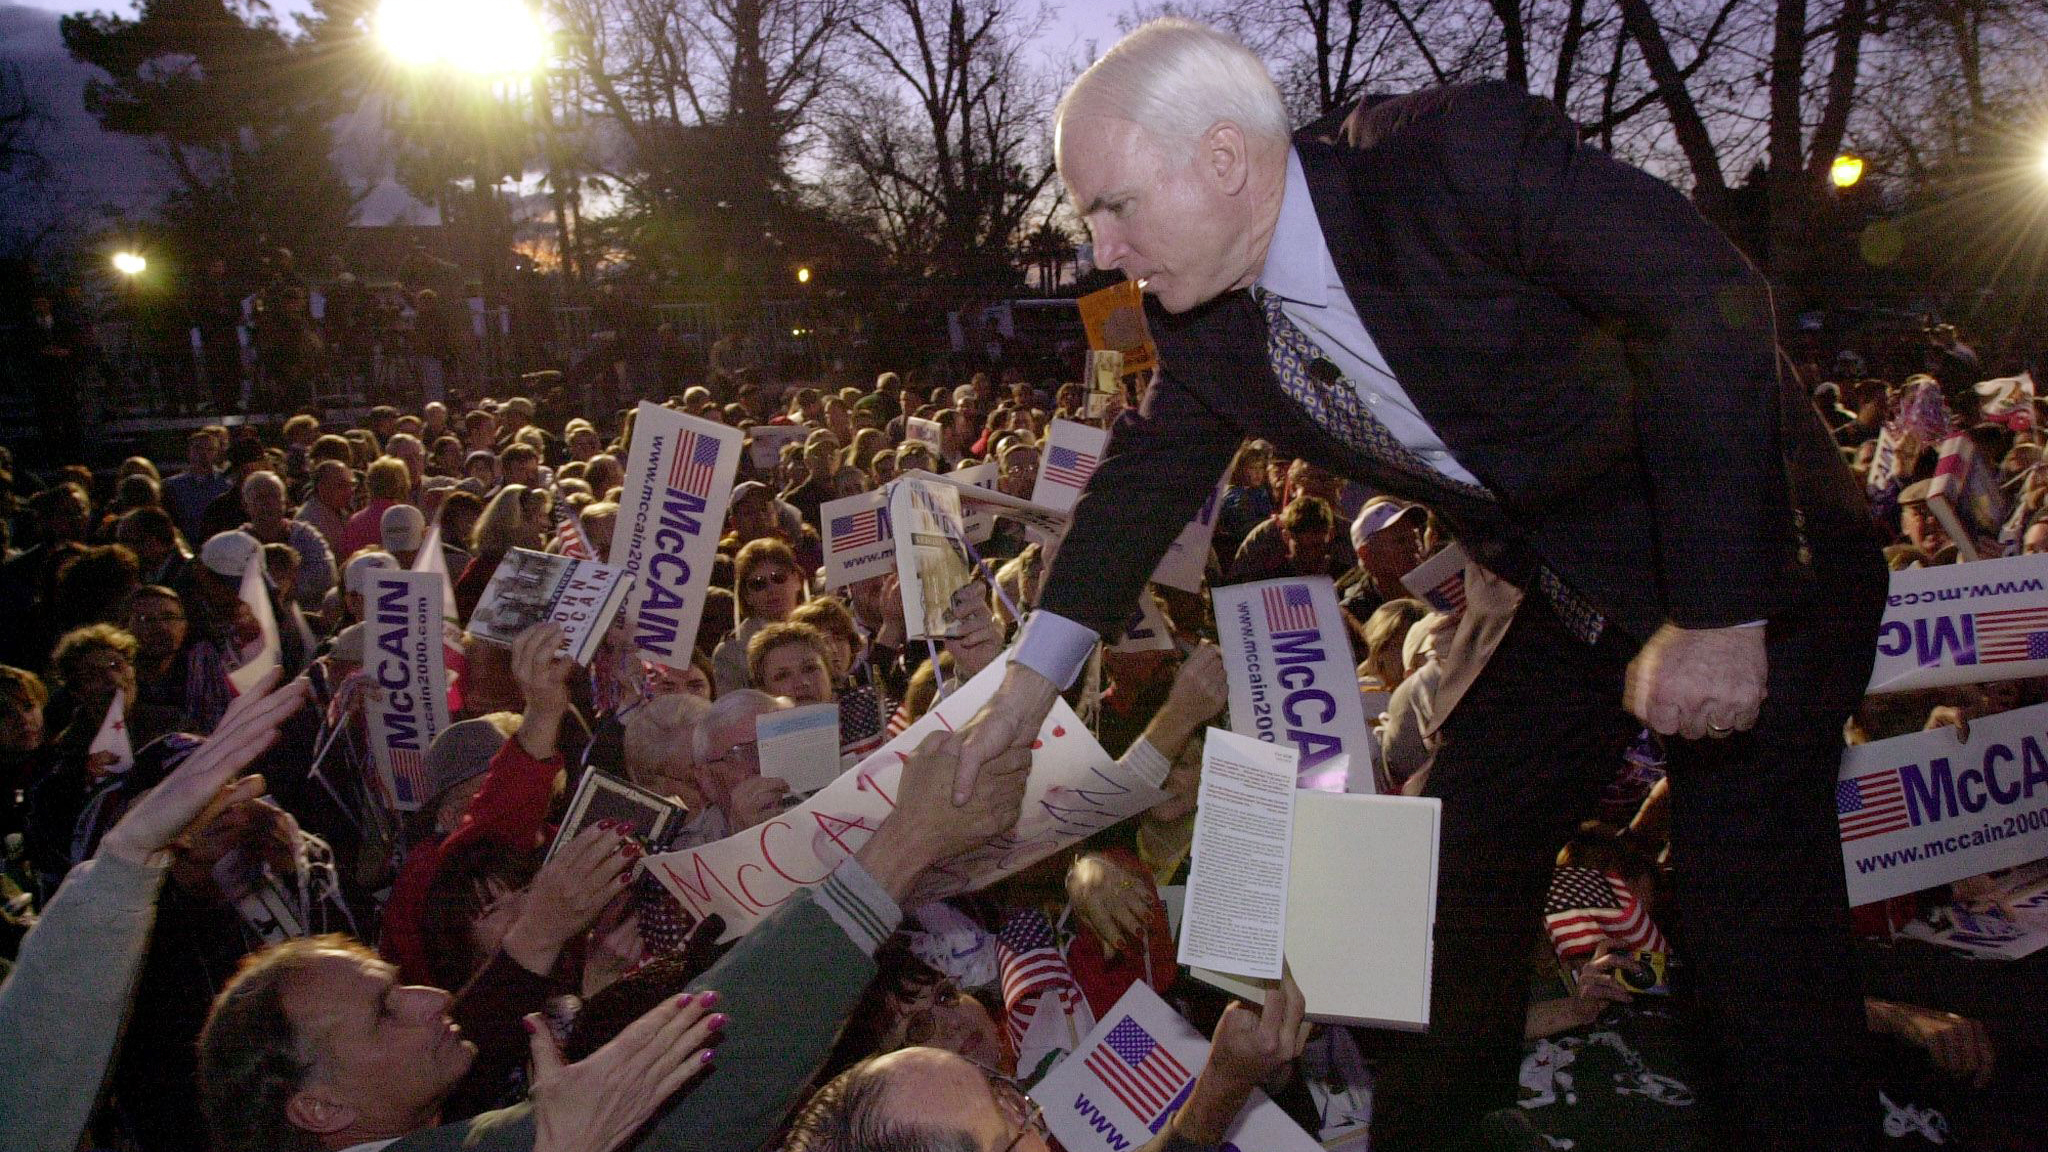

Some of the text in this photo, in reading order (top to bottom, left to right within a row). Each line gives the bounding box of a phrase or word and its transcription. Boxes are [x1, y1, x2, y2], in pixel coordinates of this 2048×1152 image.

[554, 580, 587, 621] OHN
[634, 487, 707, 657] McCAIN
[376, 580, 421, 750] McCAIN
